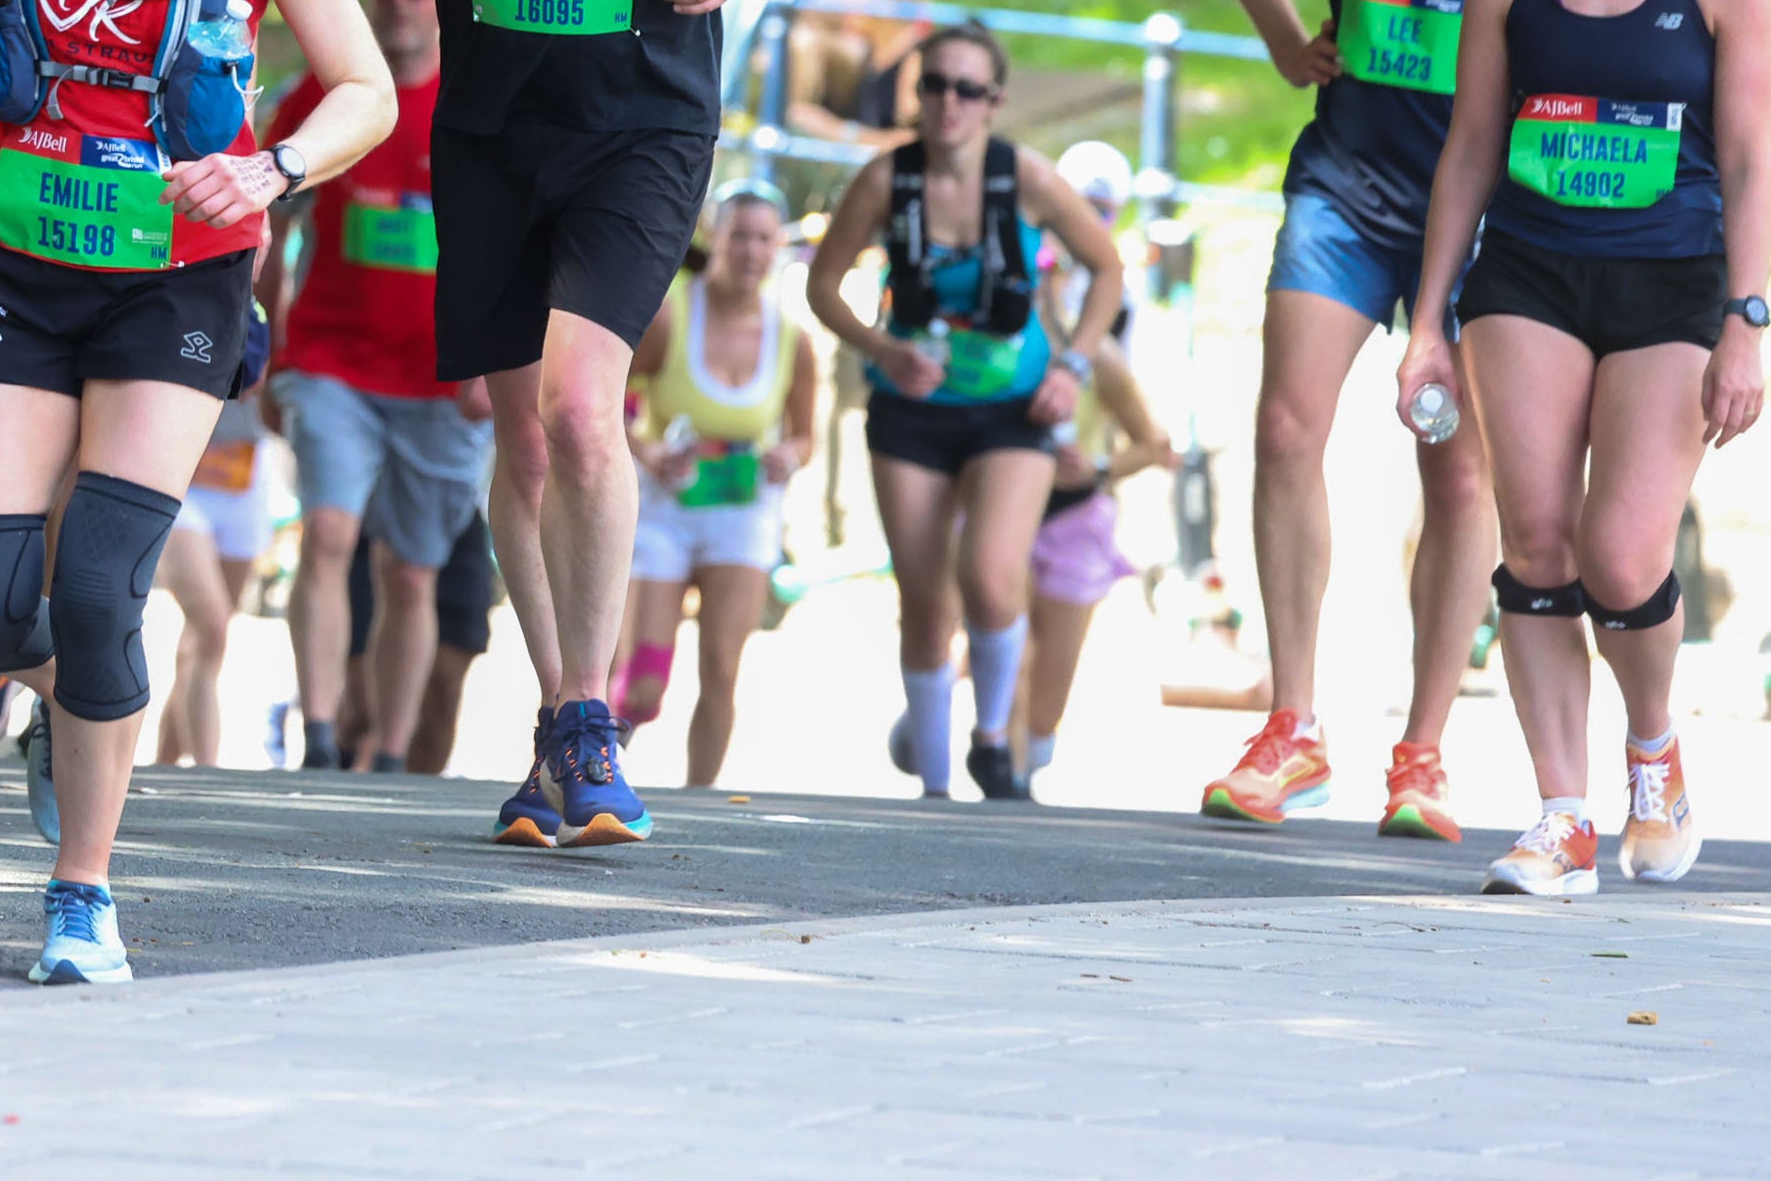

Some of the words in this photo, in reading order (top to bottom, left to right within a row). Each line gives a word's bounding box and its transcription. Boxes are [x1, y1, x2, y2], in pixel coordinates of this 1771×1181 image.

[614, 12, 628, 24] HM
[1388, 14, 1424, 44] LEE
[68, 41, 155, 64] STRAU
[1367, 46, 1433, 83] 15423
[29, 130, 68, 153] AJBell
[1541, 131, 1647, 163] MICHAELA
[39, 172, 119, 212] EMILIE
[1556, 170, 1625, 199] 14902
[38, 216, 116, 257] 15198
[151, 246, 167, 260] HM
